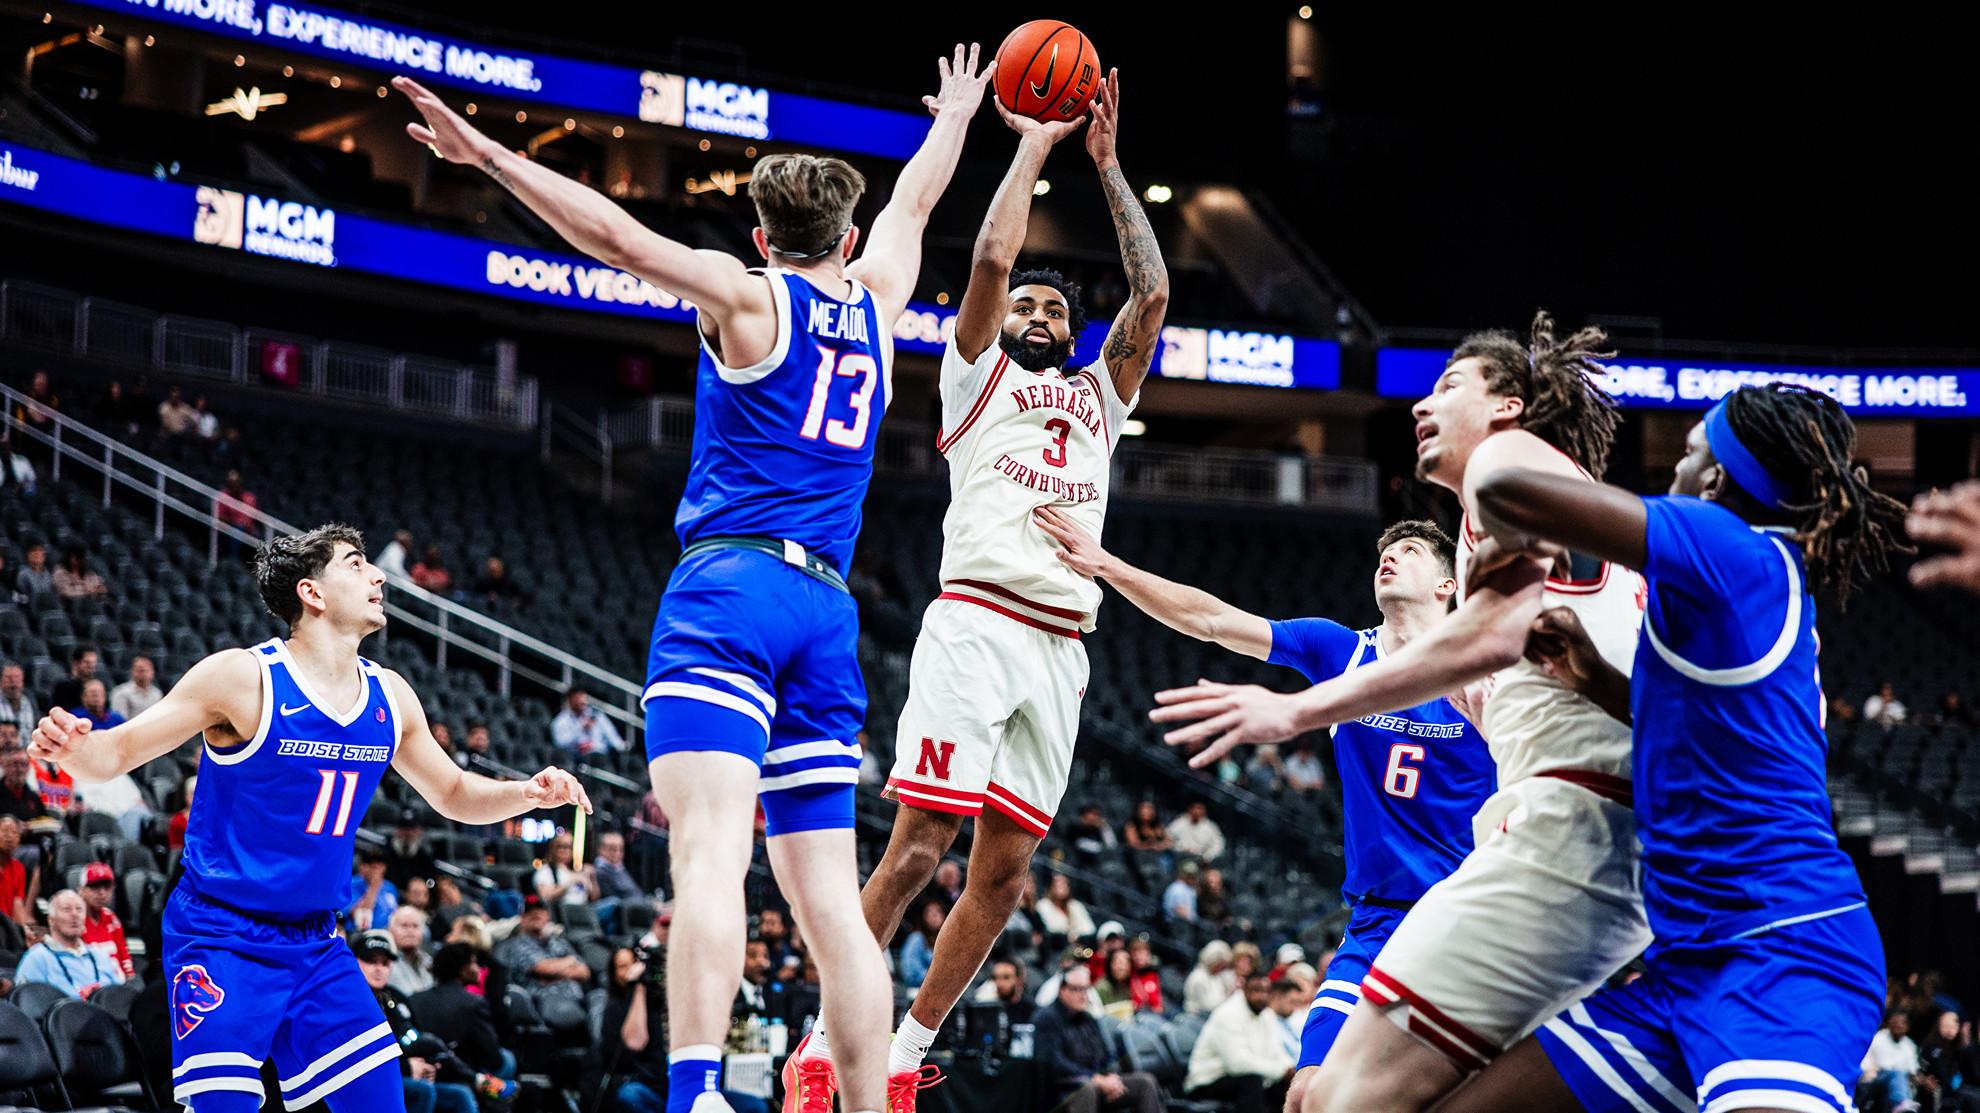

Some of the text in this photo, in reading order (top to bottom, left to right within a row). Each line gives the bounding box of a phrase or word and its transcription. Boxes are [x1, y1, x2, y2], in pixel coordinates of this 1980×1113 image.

[267, 3, 443, 72] EXPERIENCE
[445, 44, 542, 92] MORE.
[686, 77, 769, 120] MGM
[1057, 62, 1094, 116] ELITE
[246, 194, 335, 245] MGM
[486, 250, 572, 297] BOOK
[807, 298, 870, 345] MEADO
[1208, 329, 1294, 370] MGM
[799, 344, 877, 450] 13
[1010, 384, 1101, 438] NEBRASKA
[1864, 374, 1967, 407] MORE.
[1042, 417, 1072, 469] 3
[993, 454, 1100, 503] CORNHUSKERS
[277, 738, 390, 762] BOISE STATE
[1354, 713, 1465, 739] OISE STATE
[914, 736, 957, 782] N
[1383, 743, 1426, 800] 6
[305, 769, 360, 837] 11
